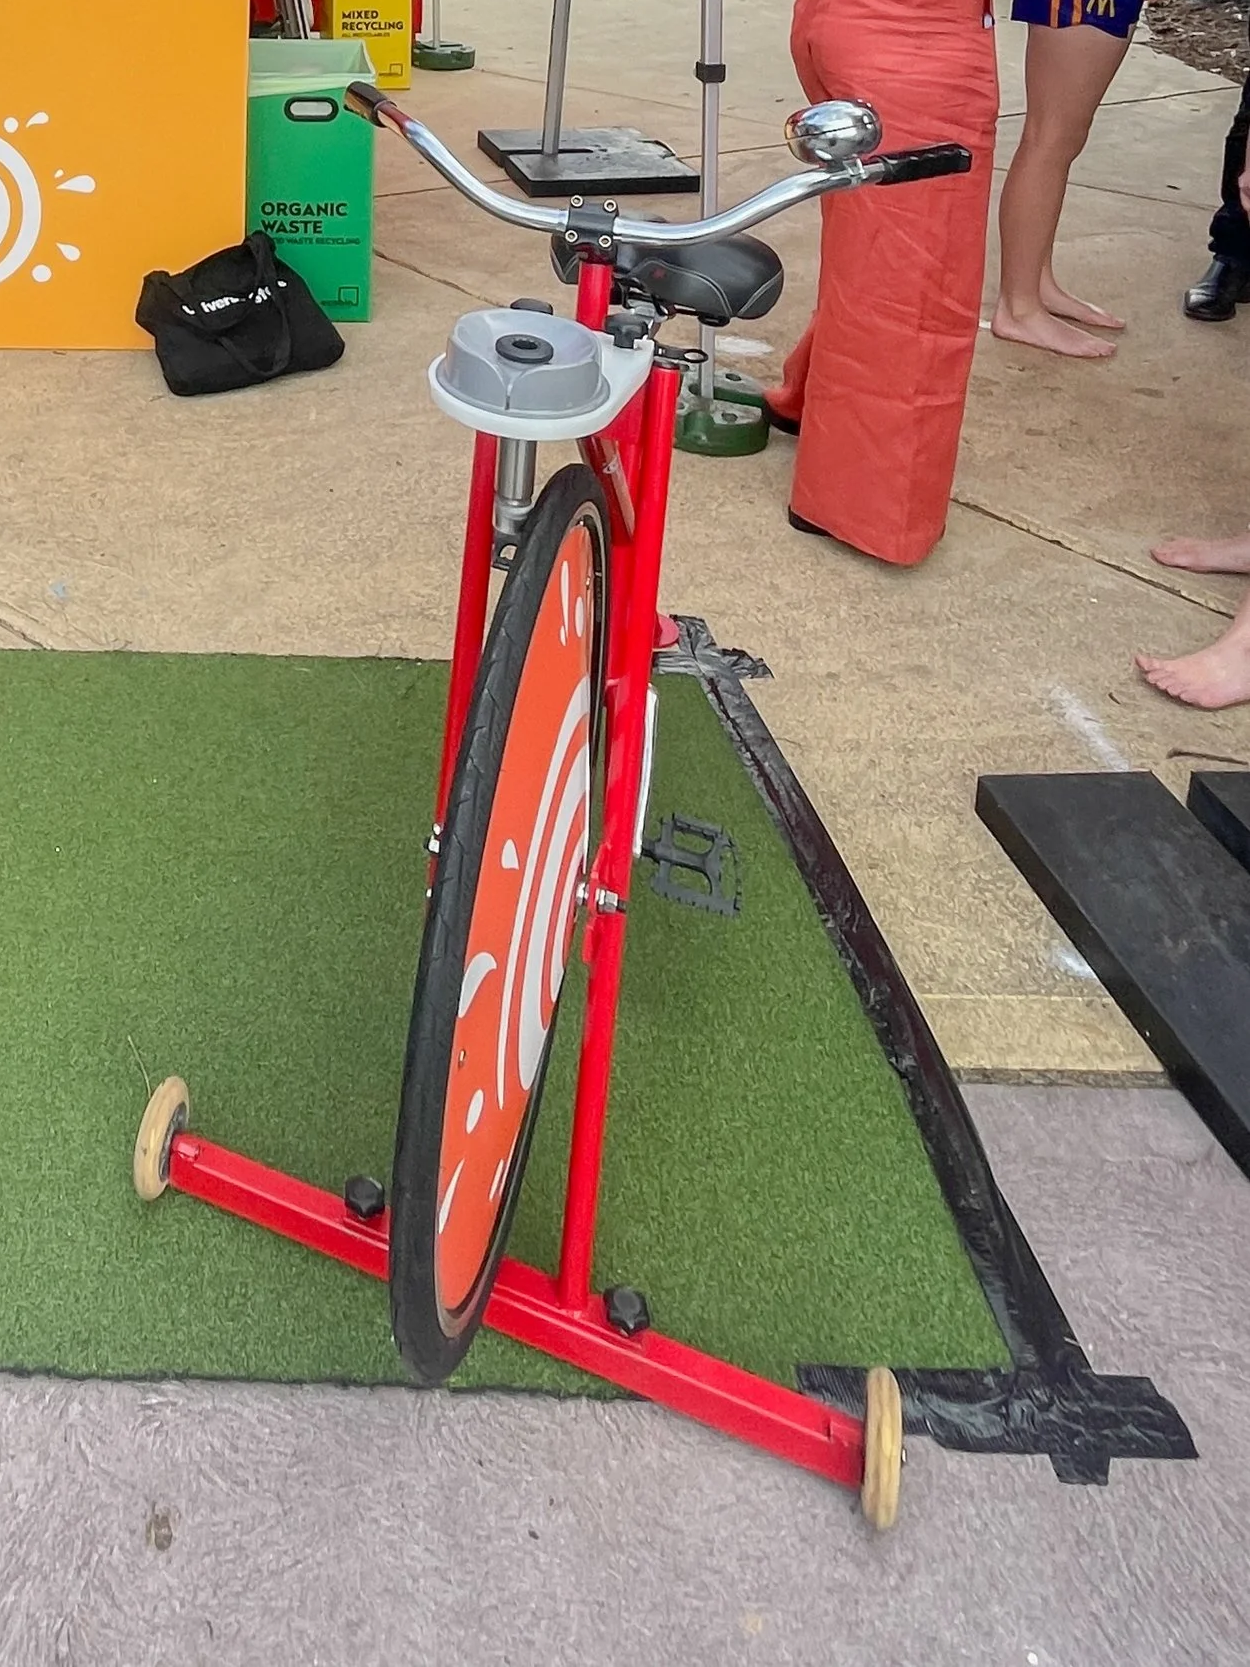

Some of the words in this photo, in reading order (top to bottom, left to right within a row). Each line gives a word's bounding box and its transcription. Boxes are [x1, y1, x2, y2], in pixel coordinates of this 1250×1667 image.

[342, 10, 379, 20] MIXED
[342, 21, 404, 31] RECYCLING
[261, 202, 348, 217] ORGANIC
[261, 220, 323, 234] WASTE
